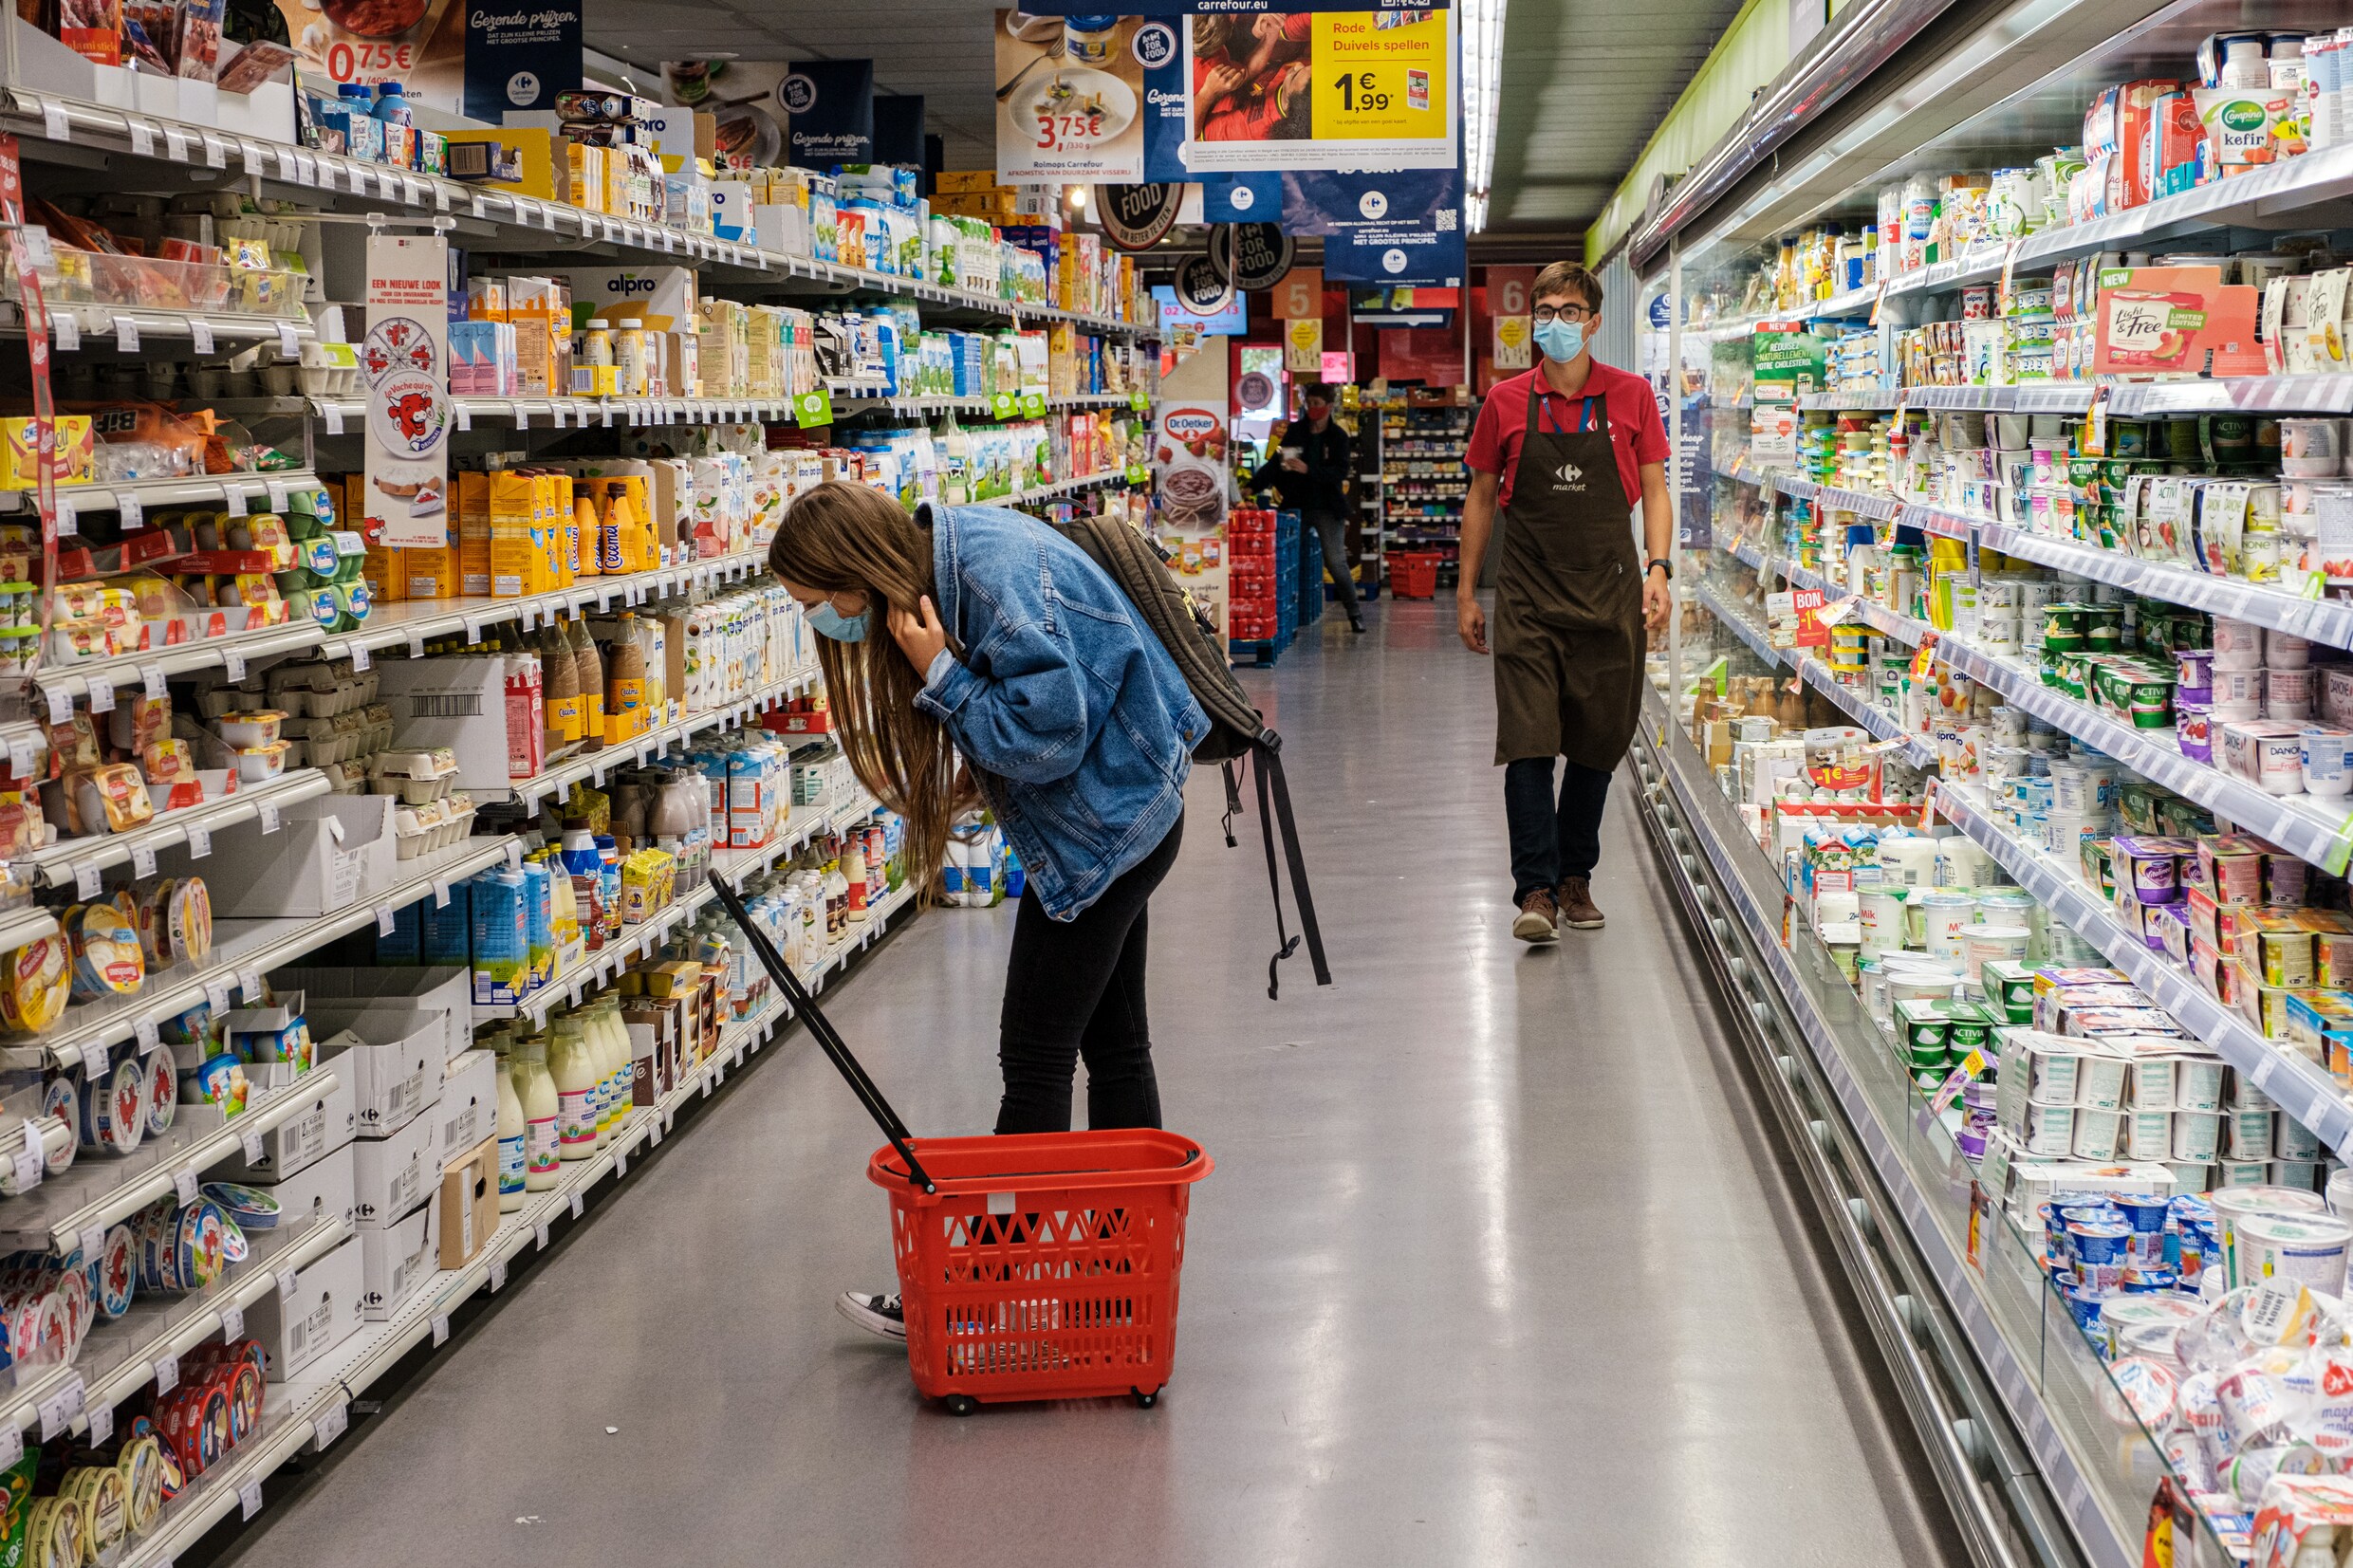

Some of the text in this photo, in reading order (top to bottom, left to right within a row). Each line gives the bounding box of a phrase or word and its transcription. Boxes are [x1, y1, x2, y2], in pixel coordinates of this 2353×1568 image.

[1198, 0, 1268, 9] carrefour.eu
[471, 9, 577, 32] Gezonde prijzen,
[1333, 23, 1365, 34] Rode
[1145, 40, 1161, 51] FOR
[1333, 39, 1430, 52] Duivels spellen
[1144, 46, 1167, 61] FOOD
[400, 90, 422, 99] aten
[1147, 88, 1185, 106] Gezon
[2224, 108, 2263, 123] Campina
[639, 119, 666, 134] pro
[792, 131, 833, 147] Gezonde
[2224, 131, 2265, 145] kefir
[1033, 159, 1103, 170] Rolmops Carrefour
[1121, 183, 1161, 221] FOOD
[372, 280, 441, 289] EEN NIEUWE LOOK
[607, 273, 656, 296] alpro
[2103, 271, 2128, 287] NEW
[1194, 284, 1223, 304] FOOD
[1288, 284, 1310, 315] 5
[1503, 281, 1524, 313] 6
[1966, 295, 1983, 304] alpro
[2115, 305, 2143, 326] Light
[2170, 313, 2204, 323] LIMITED
[1769, 323, 1788, 331] NEW
[2118, 313, 2161, 338] & Free
[2170, 319, 2202, 328] EDITION
[1769, 341, 1799, 351] RÉDUISEZ
[1756, 359, 1812, 371] VOTRE CHOLESTÉROL
[391, 382, 412, 395] Vache
[414, 383, 424, 392] qui
[425, 384, 434, 393] rit
[1169, 418, 1213, 429] Dr. Oetker
[420, 430, 441, 450] ORIGINAL
[2070, 464, 2093, 474] ACTIVIA
[1552, 483, 1586, 491] market
[603, 524, 623, 570] Cécémel
[1796, 592, 1821, 608] BON
[1816, 767, 1843, 784] -1€
[1954, 1028, 1985, 1038] ACTIVIA
[2253, 1288, 2275, 1326] YOGHURT
[2265, 1293, 2287, 1328] YAOURT
[2321, 1408, 2353, 1423] mage
